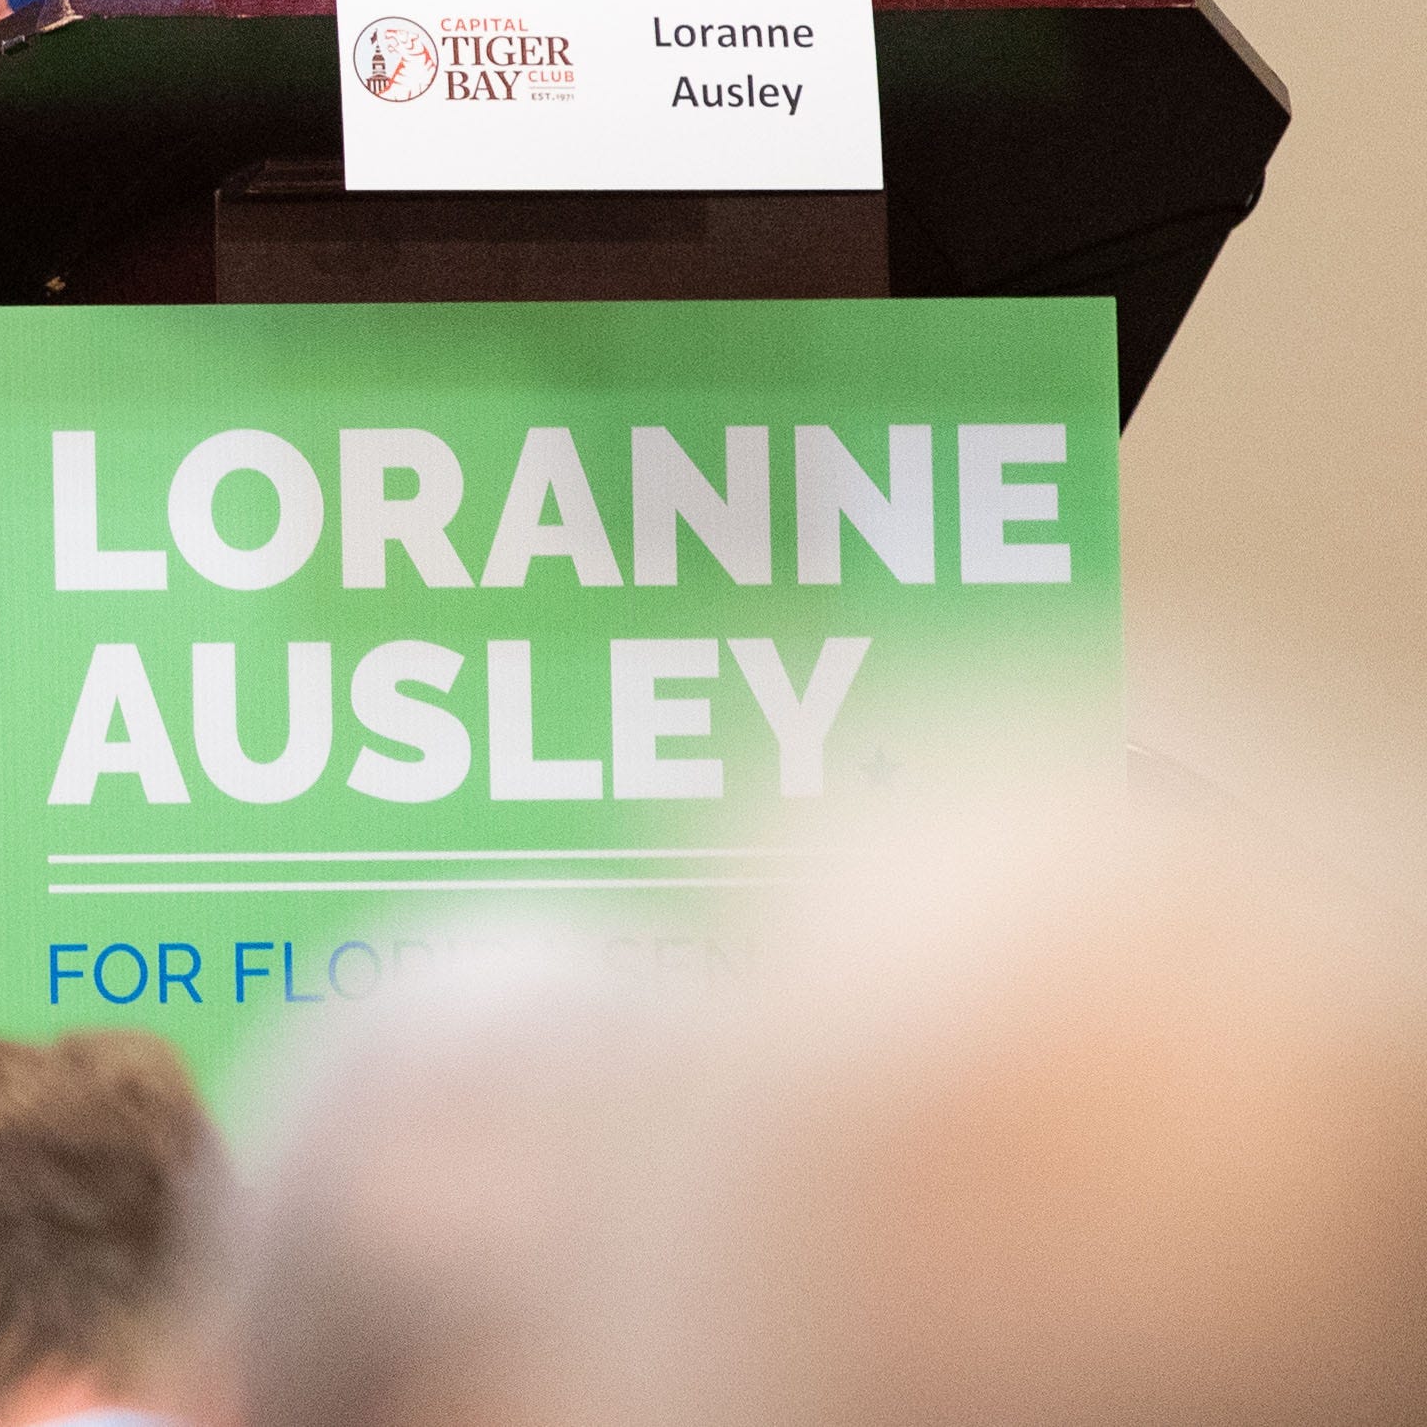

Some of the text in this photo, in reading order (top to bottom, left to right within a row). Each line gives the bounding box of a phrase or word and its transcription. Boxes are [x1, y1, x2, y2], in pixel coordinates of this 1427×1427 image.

[441, 17, 528, 32] CAPITAL
[654, 16, 814, 49] Loranne
[441, 35, 574, 66] TIGER
[445, 70, 575, 101] BAY CLUB
[671, 73, 803, 116] Ausley
[51, 424, 1072, 592] LORANNE
[46, 636, 873, 805] AUSLEY
[48, 943, 203, 1005] FOR
